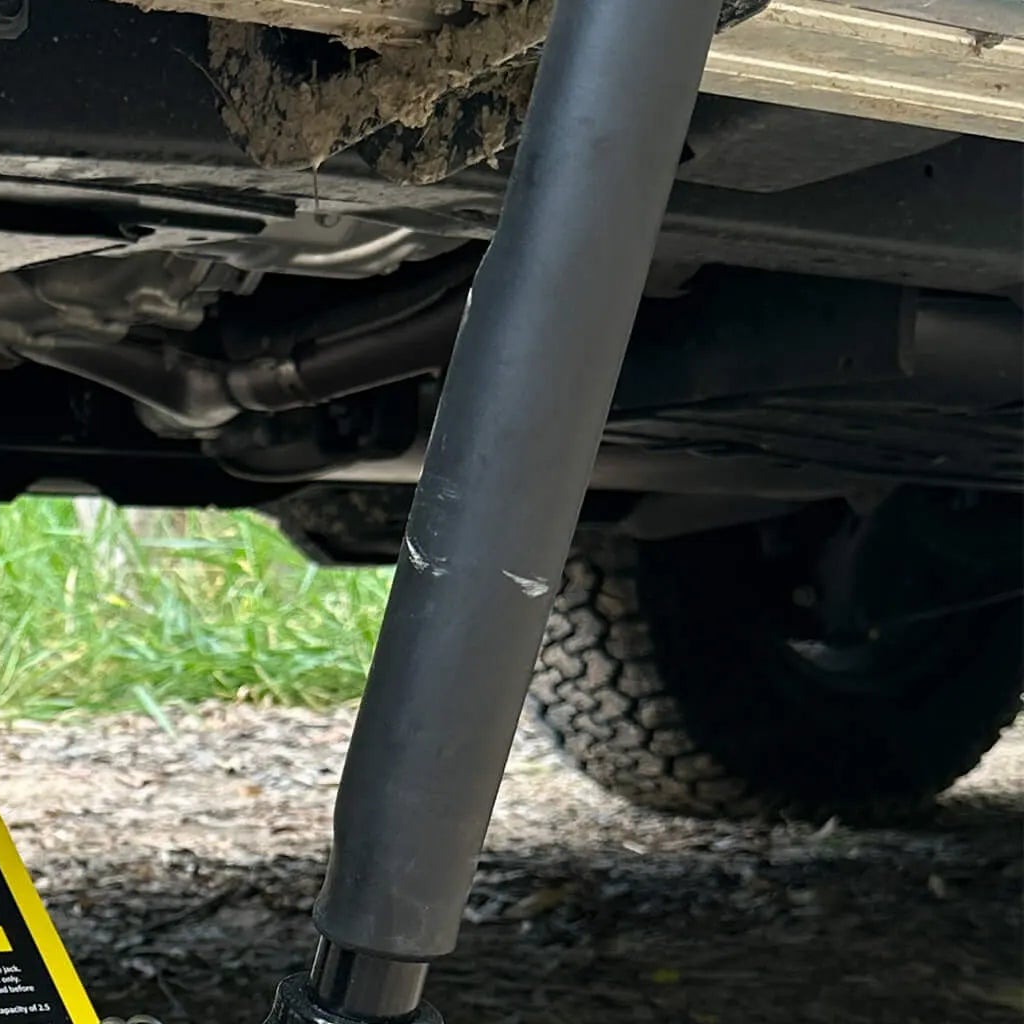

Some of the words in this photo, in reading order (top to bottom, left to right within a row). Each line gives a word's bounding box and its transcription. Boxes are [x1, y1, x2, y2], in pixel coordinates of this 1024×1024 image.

[2, 965, 22, 974] jack.
[1, 975, 21, 984] only.
[8, 984, 35, 993] before
[28, 1003, 38, 1012] of
[37, 1003, 51, 1012] 2.5
